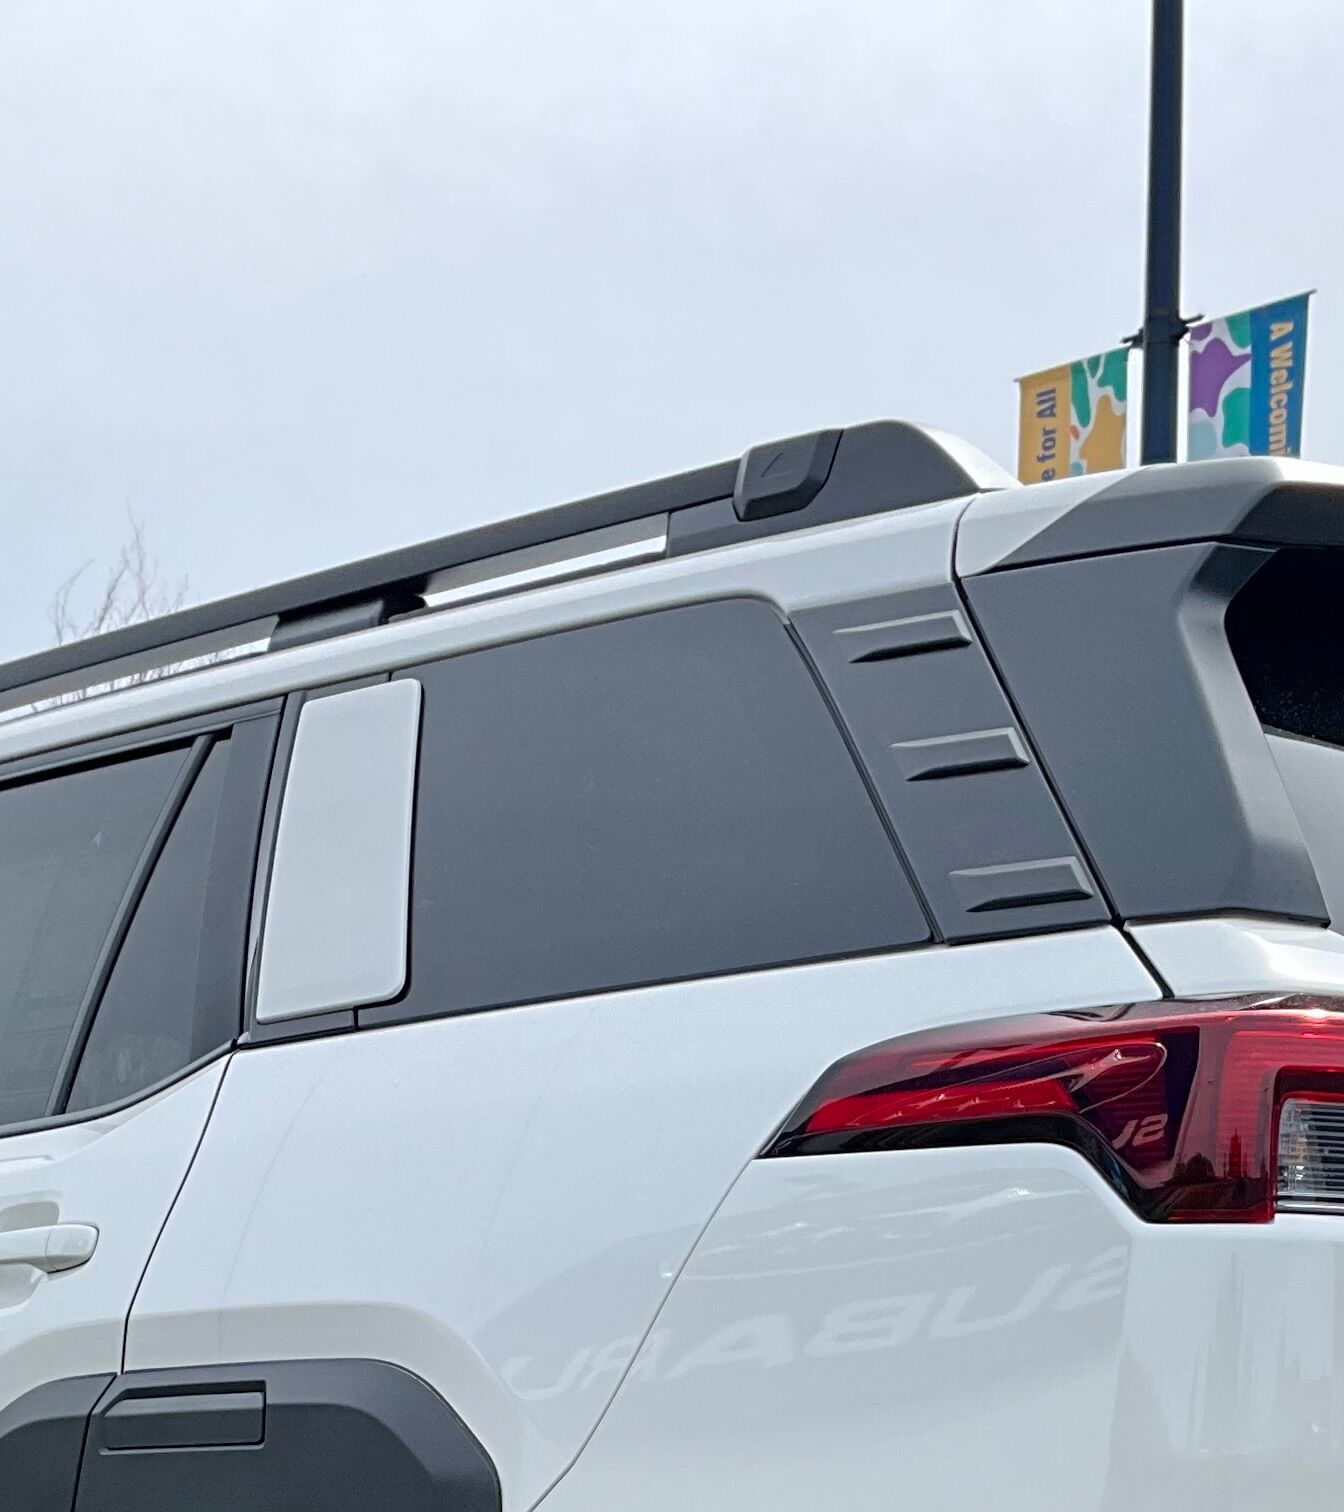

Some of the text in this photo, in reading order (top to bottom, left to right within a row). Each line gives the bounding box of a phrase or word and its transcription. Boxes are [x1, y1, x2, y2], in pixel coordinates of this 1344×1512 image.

[1270, 321, 1294, 341] A
[1036, 388, 1057, 418] All
[1036, 427, 1056, 463] for
